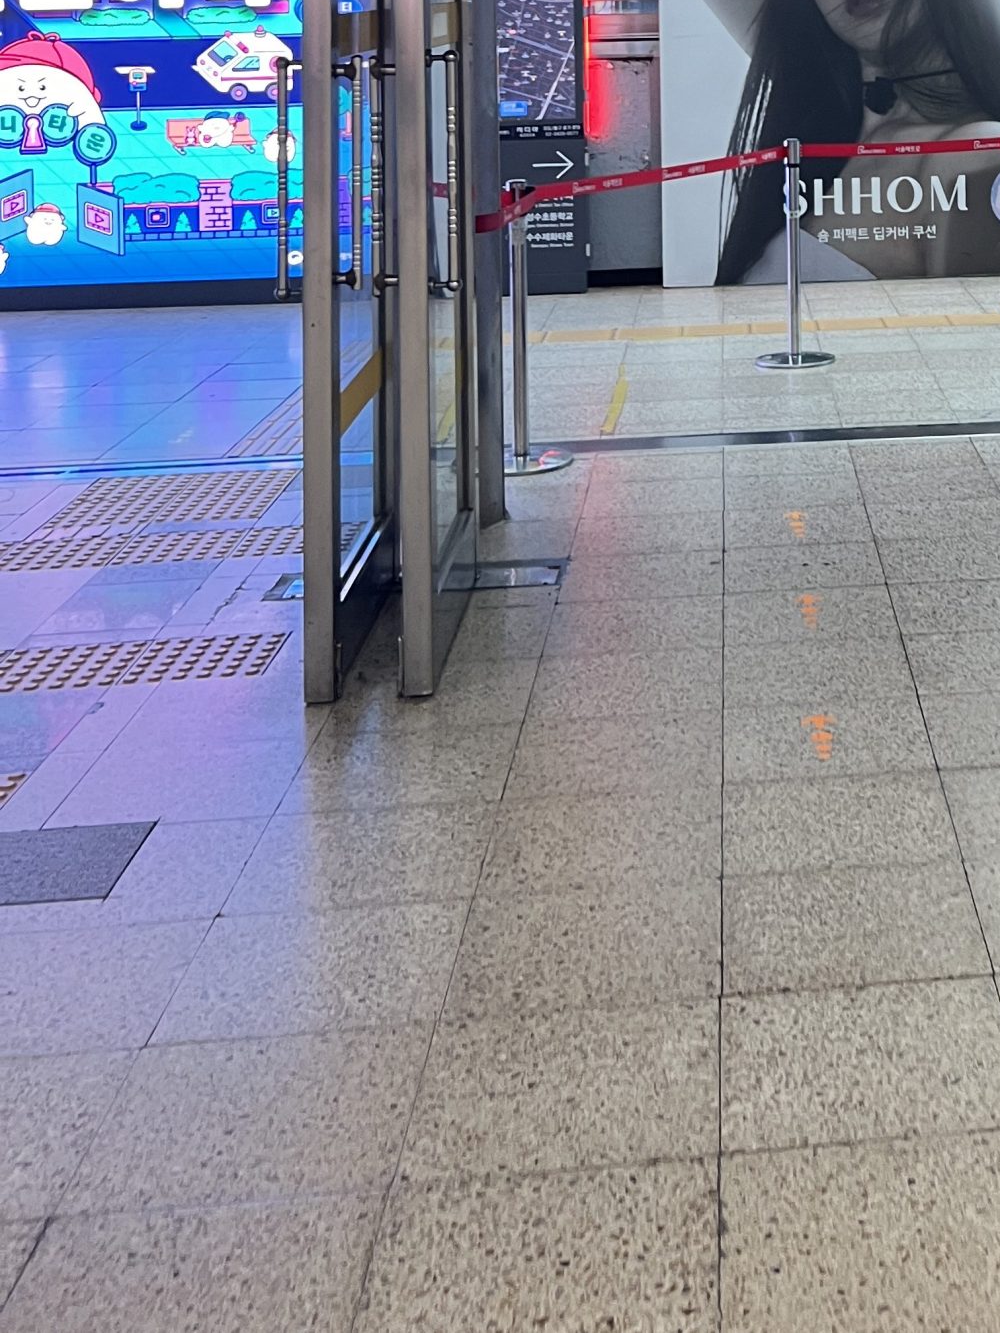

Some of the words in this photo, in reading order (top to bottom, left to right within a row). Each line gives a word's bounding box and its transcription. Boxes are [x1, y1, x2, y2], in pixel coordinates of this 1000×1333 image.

[833, 226, 870, 241] 퍼펙트
[873, 225, 909, 241] 딥커버
[913, 224, 937, 239] 쿠션
